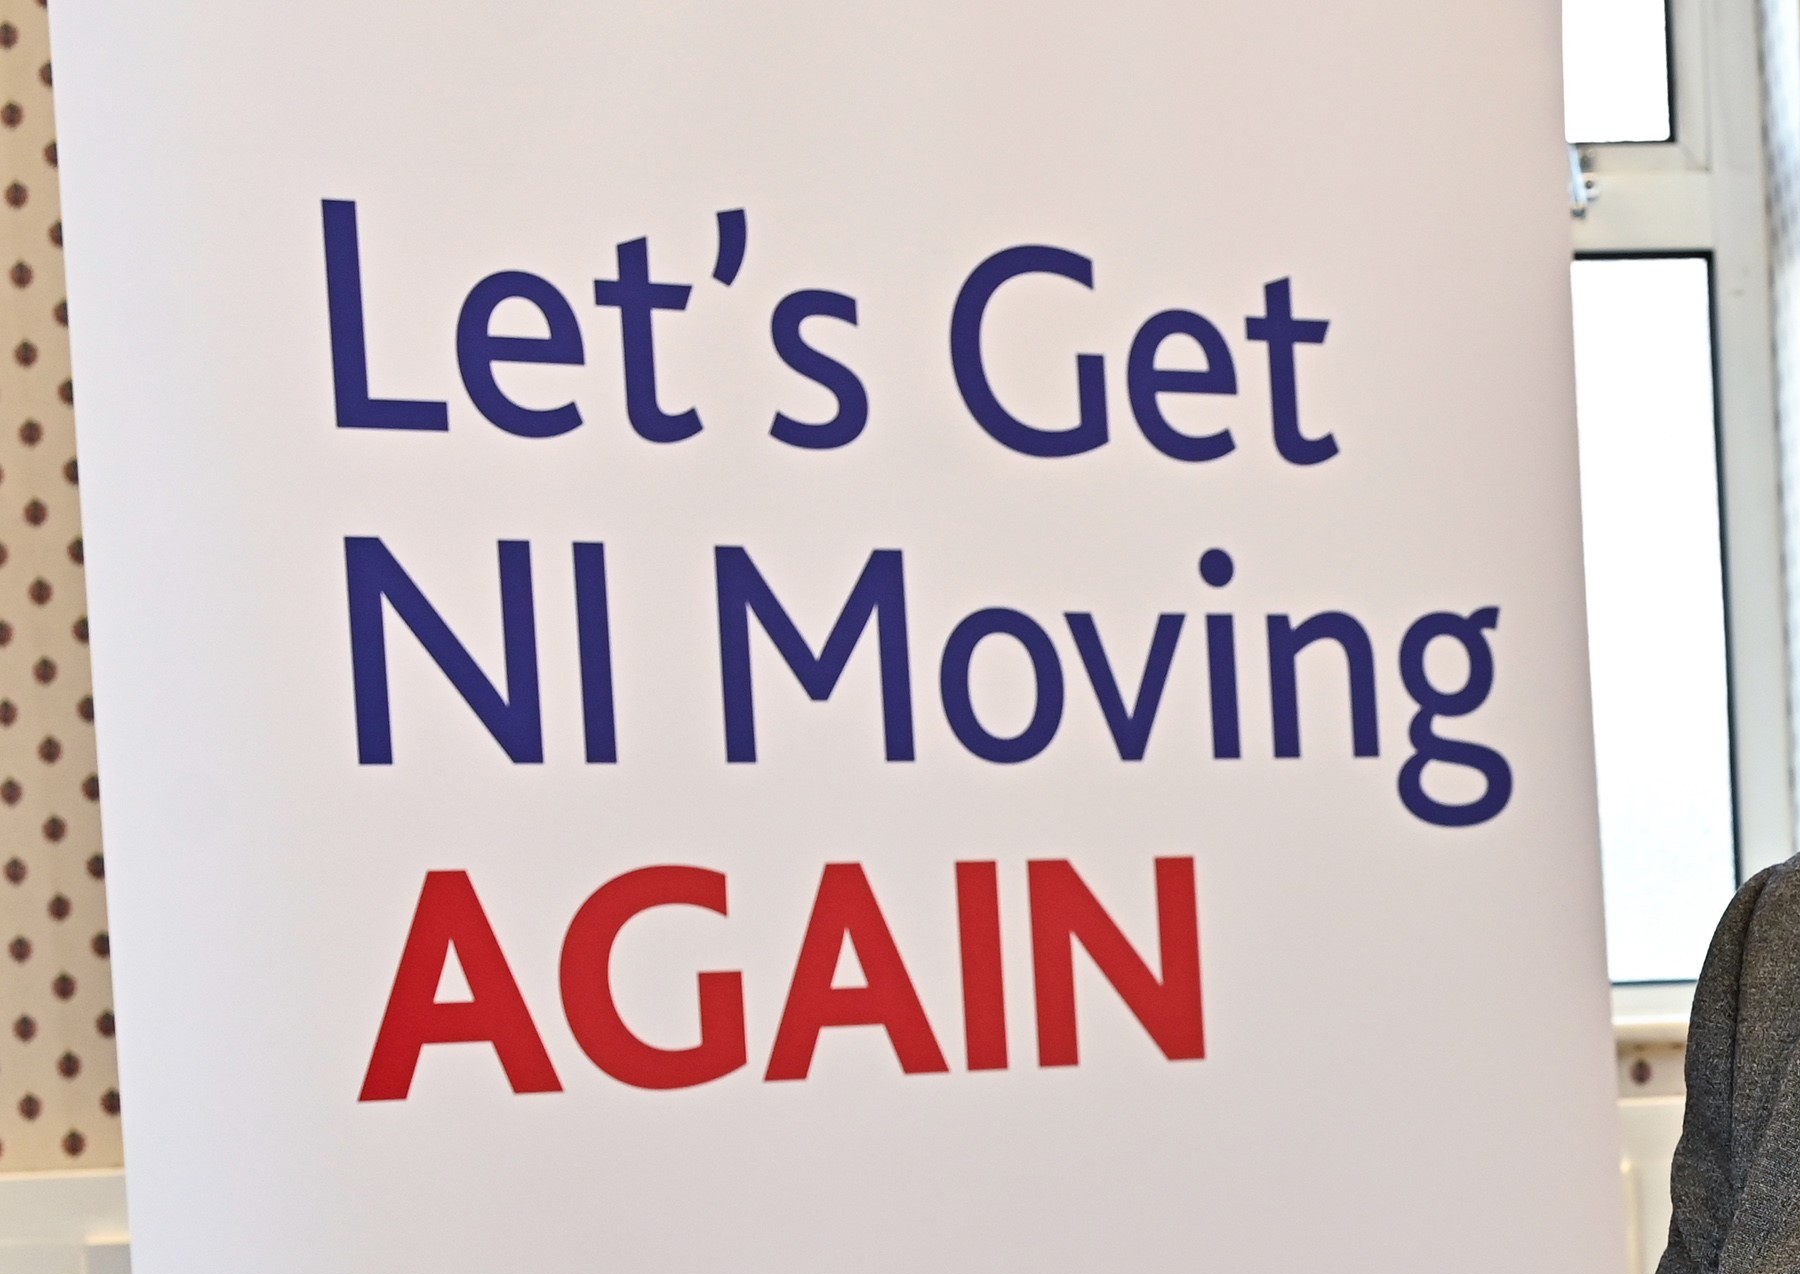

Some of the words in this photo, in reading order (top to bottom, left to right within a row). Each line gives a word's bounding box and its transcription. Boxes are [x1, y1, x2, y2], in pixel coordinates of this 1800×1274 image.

[321, 198, 869, 450] Let’s
[950, 244, 1339, 466] Get
[343, 536, 618, 765] NI
[714, 545, 1513, 828] Moving
[357, 856, 1206, 1103] AGAIN
